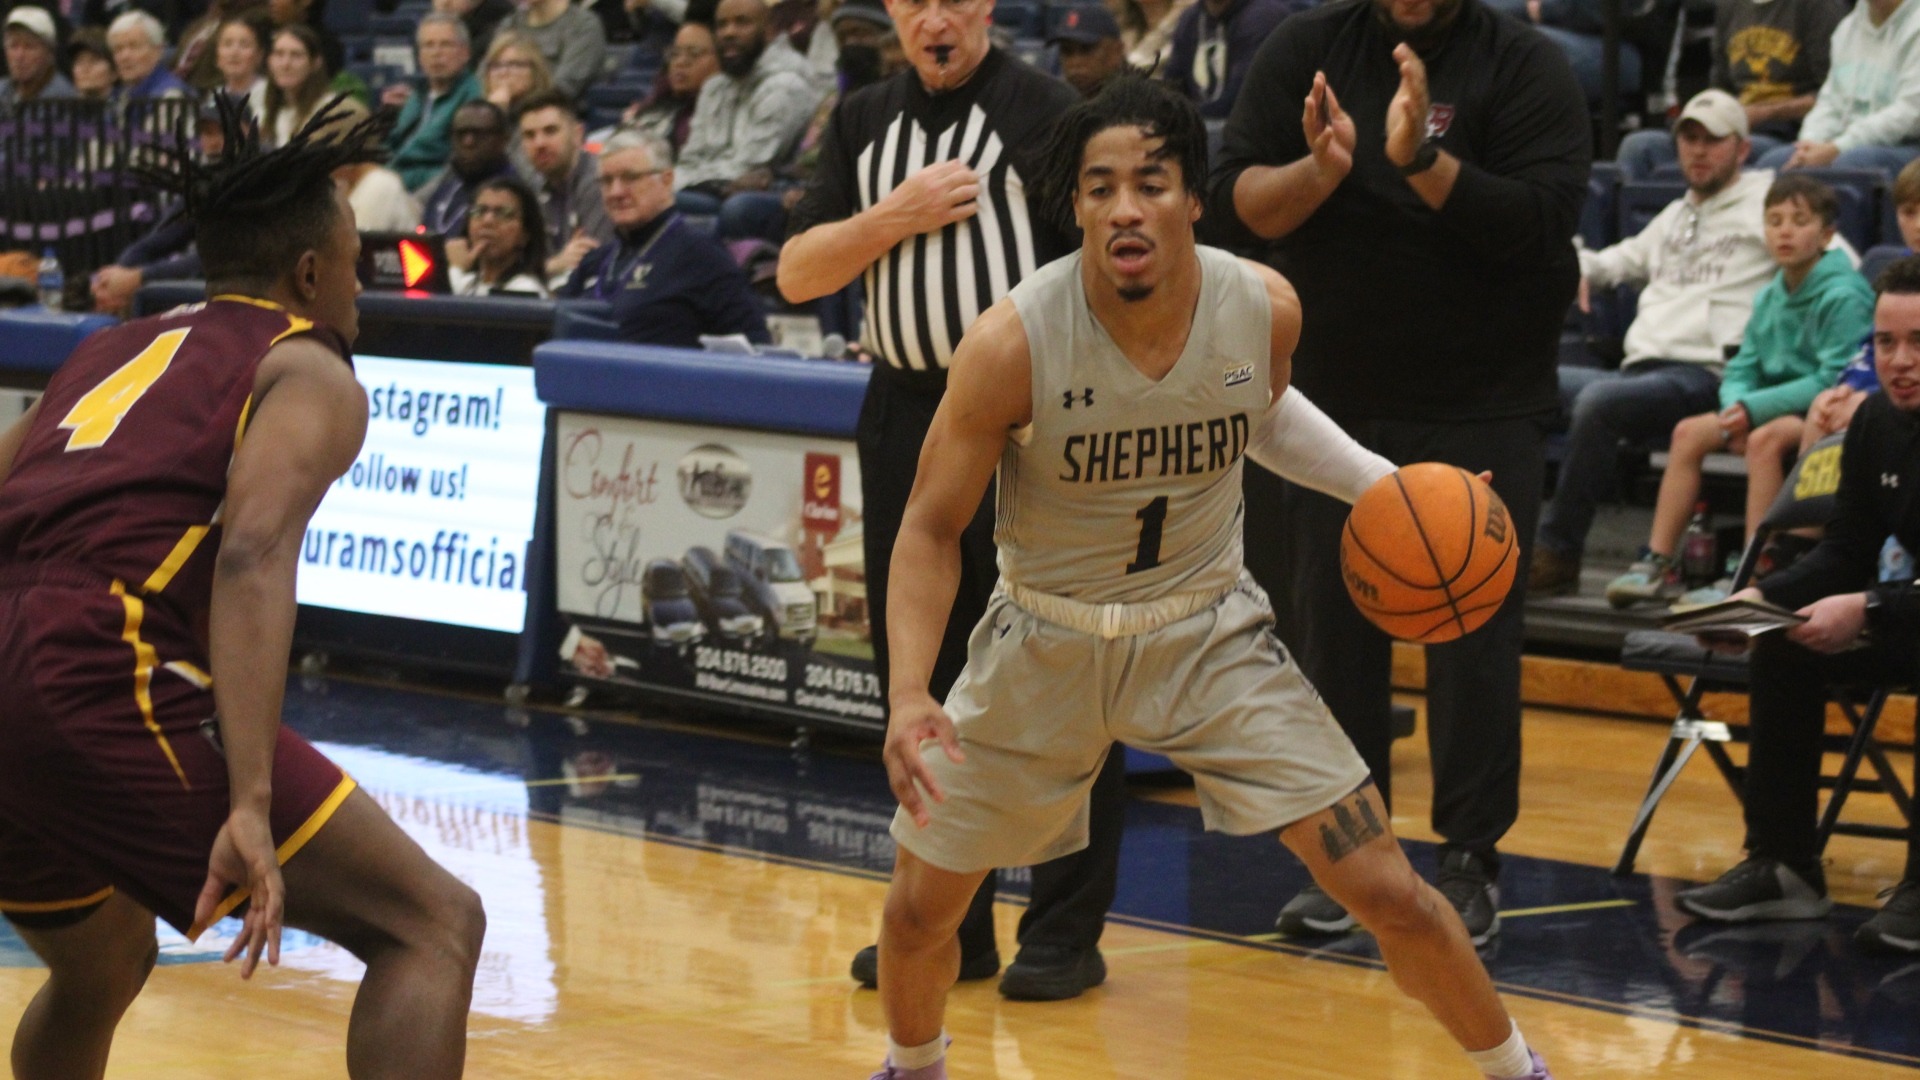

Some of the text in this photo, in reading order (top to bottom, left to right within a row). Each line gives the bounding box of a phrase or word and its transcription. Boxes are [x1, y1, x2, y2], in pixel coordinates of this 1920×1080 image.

[56, 326, 193, 453] 4
[338, 454, 468, 500] ollow us!
[1059, 412, 1250, 483] SHEPHERD
[1125, 496, 1169, 575] 1
